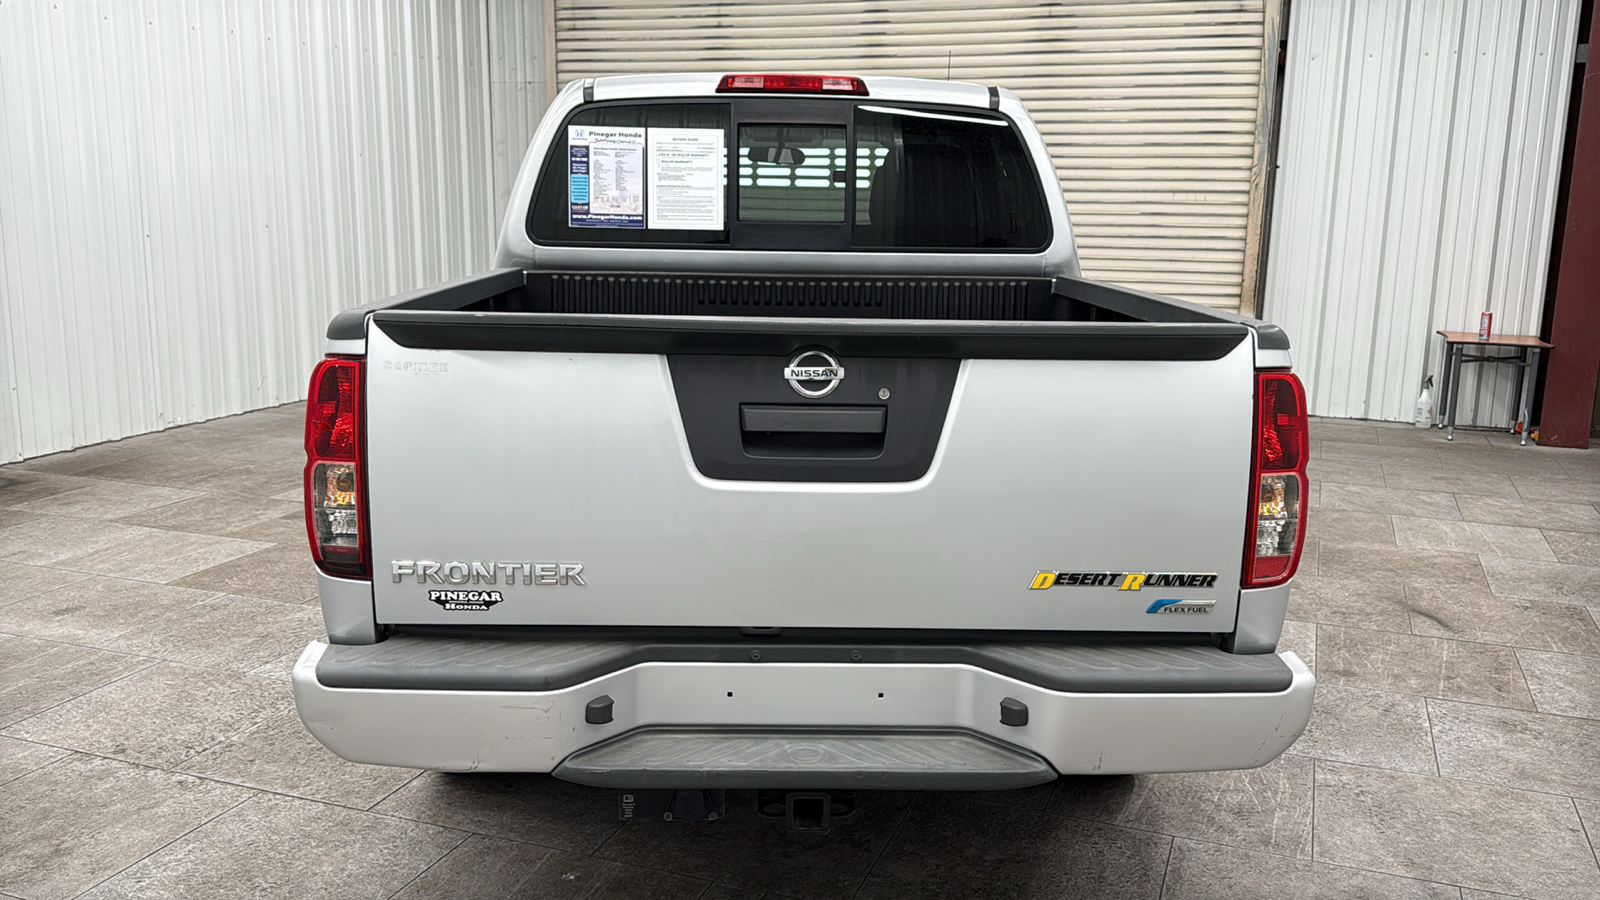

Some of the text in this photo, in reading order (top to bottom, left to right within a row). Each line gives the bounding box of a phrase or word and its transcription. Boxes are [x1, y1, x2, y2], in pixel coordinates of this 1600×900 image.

[790, 369, 838, 377] NISSAN
[391, 560, 587, 586] FRONTIER
[1030, 572, 1217, 591] DESERT RUNNER
[429, 591, 502, 602] PINEGAR
